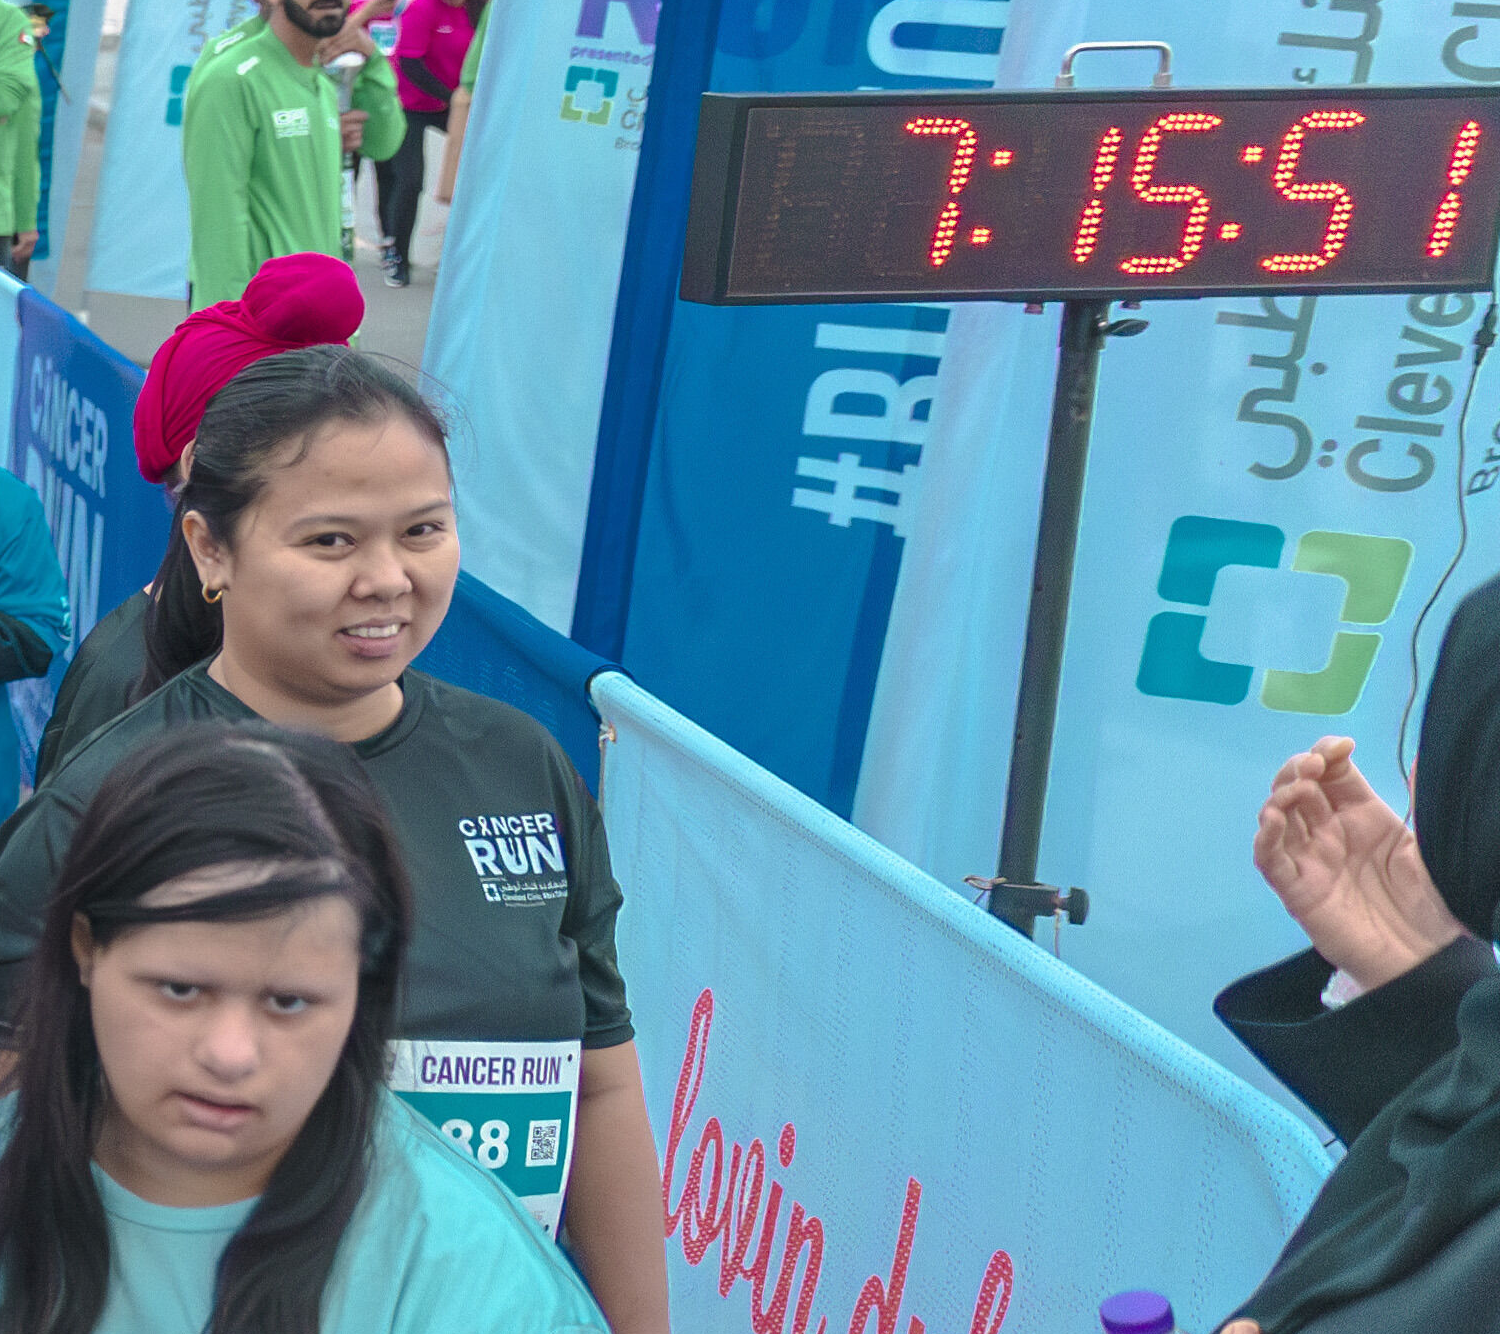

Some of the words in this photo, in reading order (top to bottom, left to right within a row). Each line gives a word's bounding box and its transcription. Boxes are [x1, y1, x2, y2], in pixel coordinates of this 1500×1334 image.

[905, 110, 1482, 275] 7:15:51
[29, 354, 109, 499] CANCER
[458, 813, 556, 837] CANCER
[464, 833, 565, 876] RUN
[421, 1055, 516, 1085] CANCER
[521, 1055, 562, 1084] RUN
